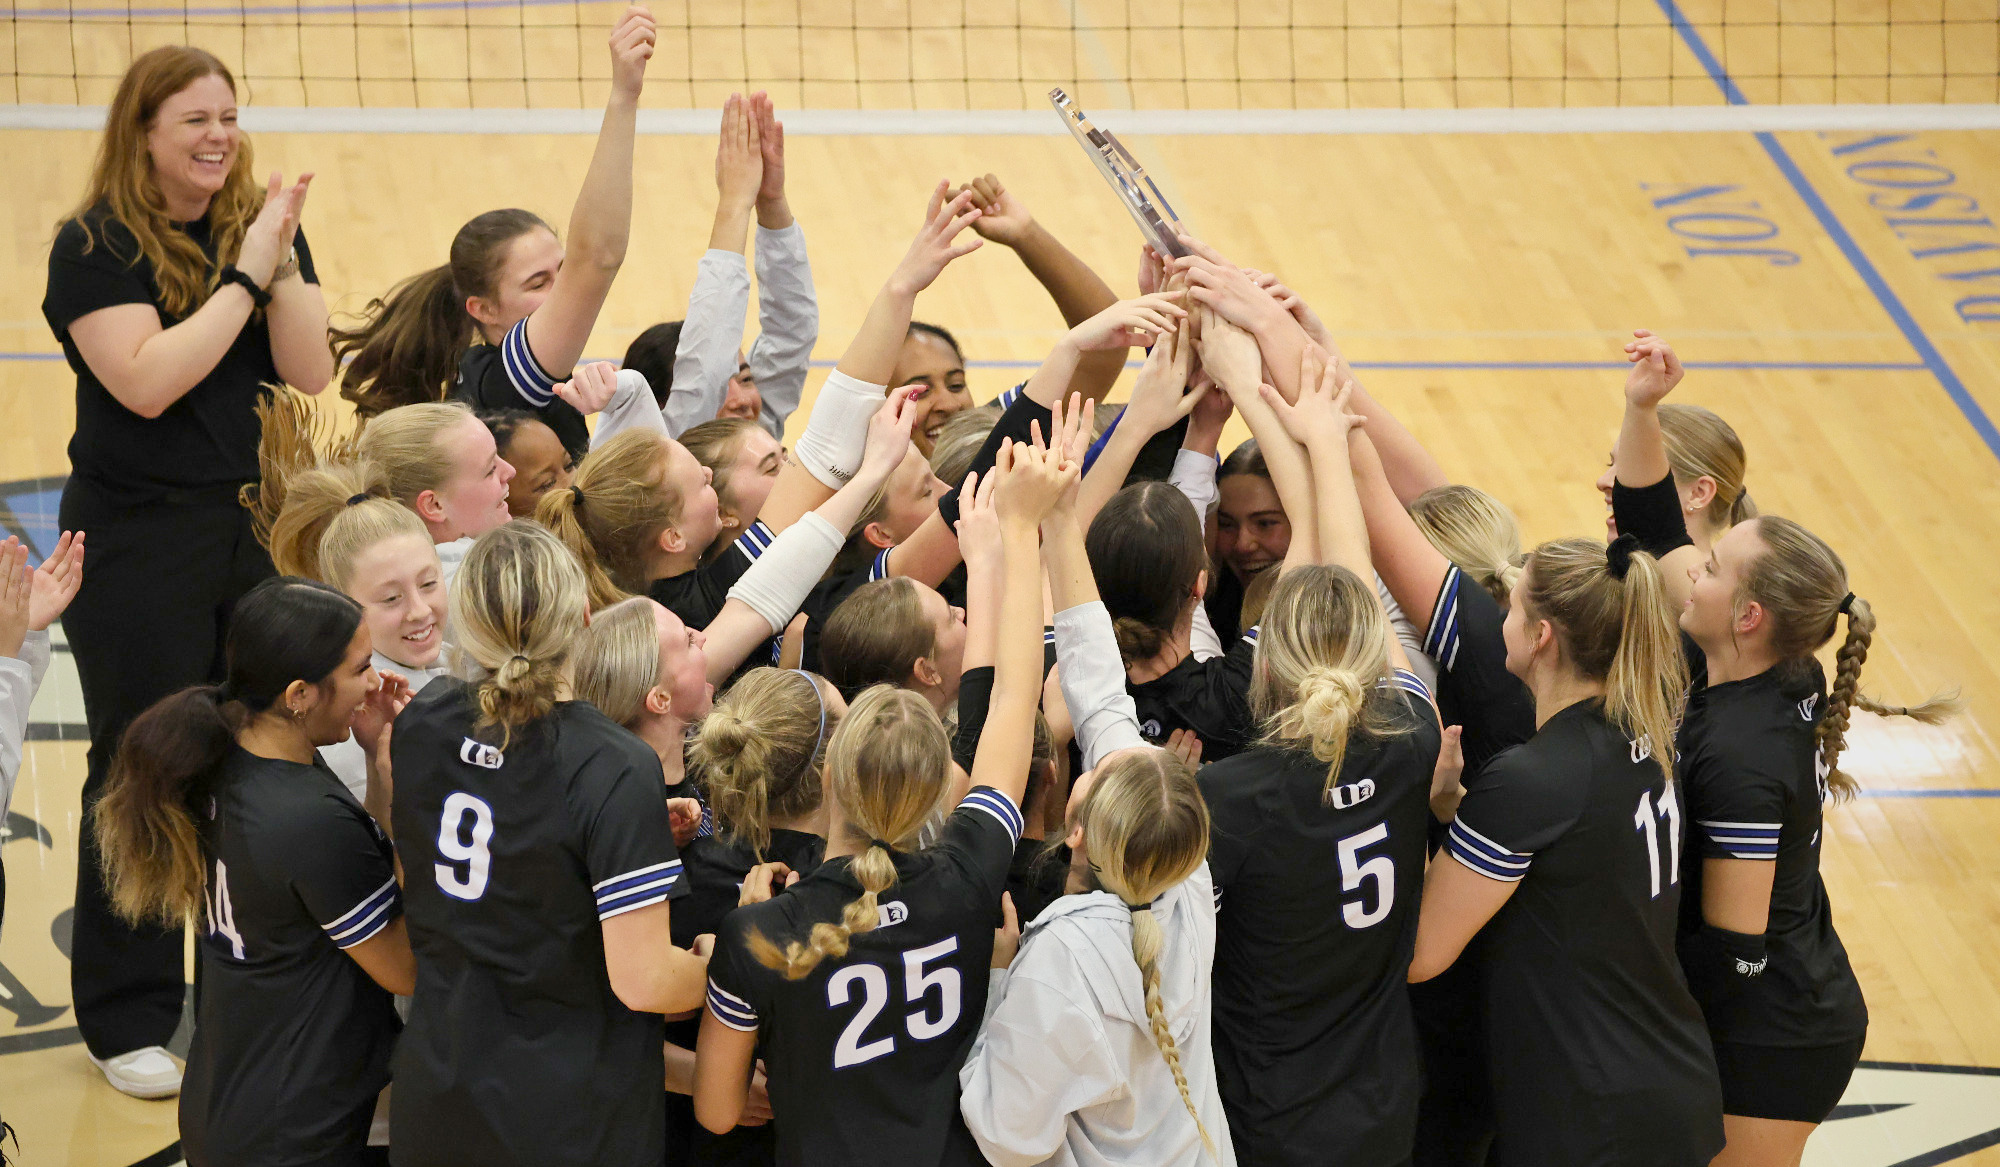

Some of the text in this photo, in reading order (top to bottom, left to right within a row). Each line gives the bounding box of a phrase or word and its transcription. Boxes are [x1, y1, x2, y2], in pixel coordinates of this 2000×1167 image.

[1638, 181, 1800, 266] JON
[434, 790, 495, 902] 9
[1336, 820, 1396, 930] 5
[1633, 779, 1680, 900] 11
[825, 934, 963, 1071] 25
